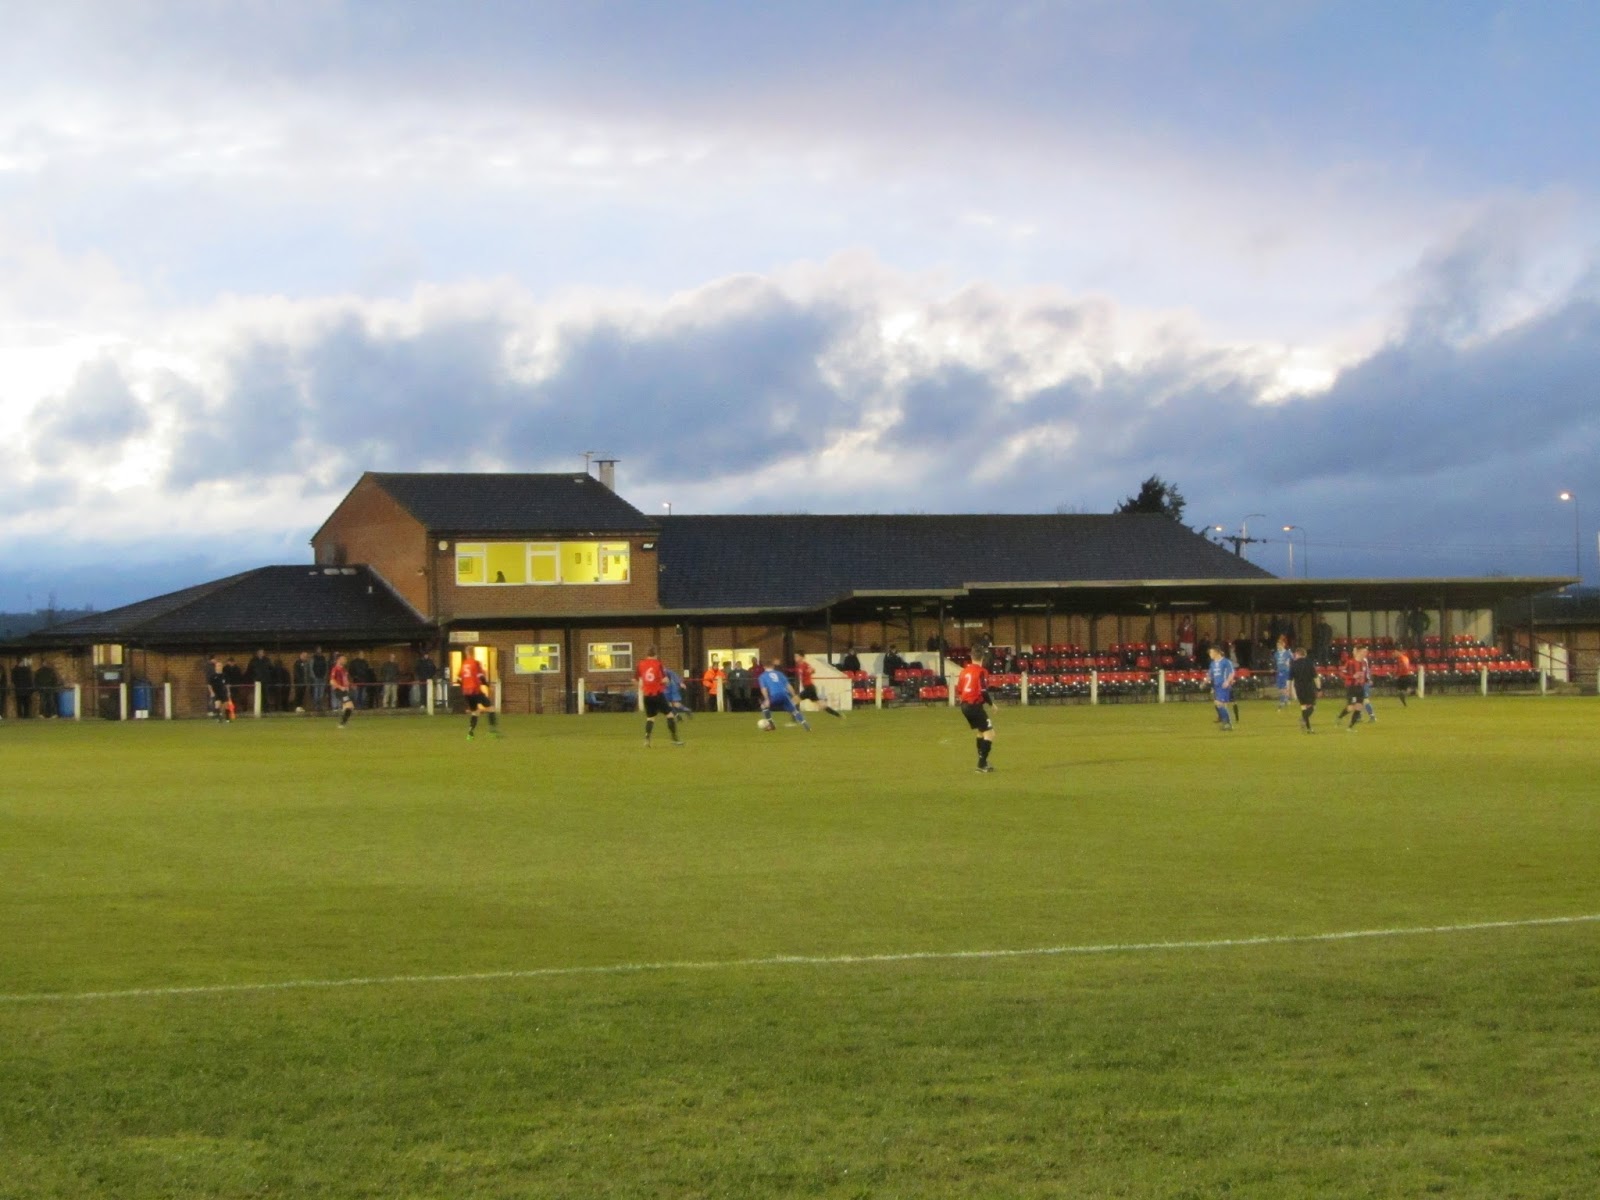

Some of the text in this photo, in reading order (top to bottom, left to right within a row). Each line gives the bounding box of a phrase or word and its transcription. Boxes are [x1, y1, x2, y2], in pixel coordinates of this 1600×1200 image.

[645, 667, 655, 682] 6
[768, 672, 779, 683] 9
[964, 673, 972, 692] 2
